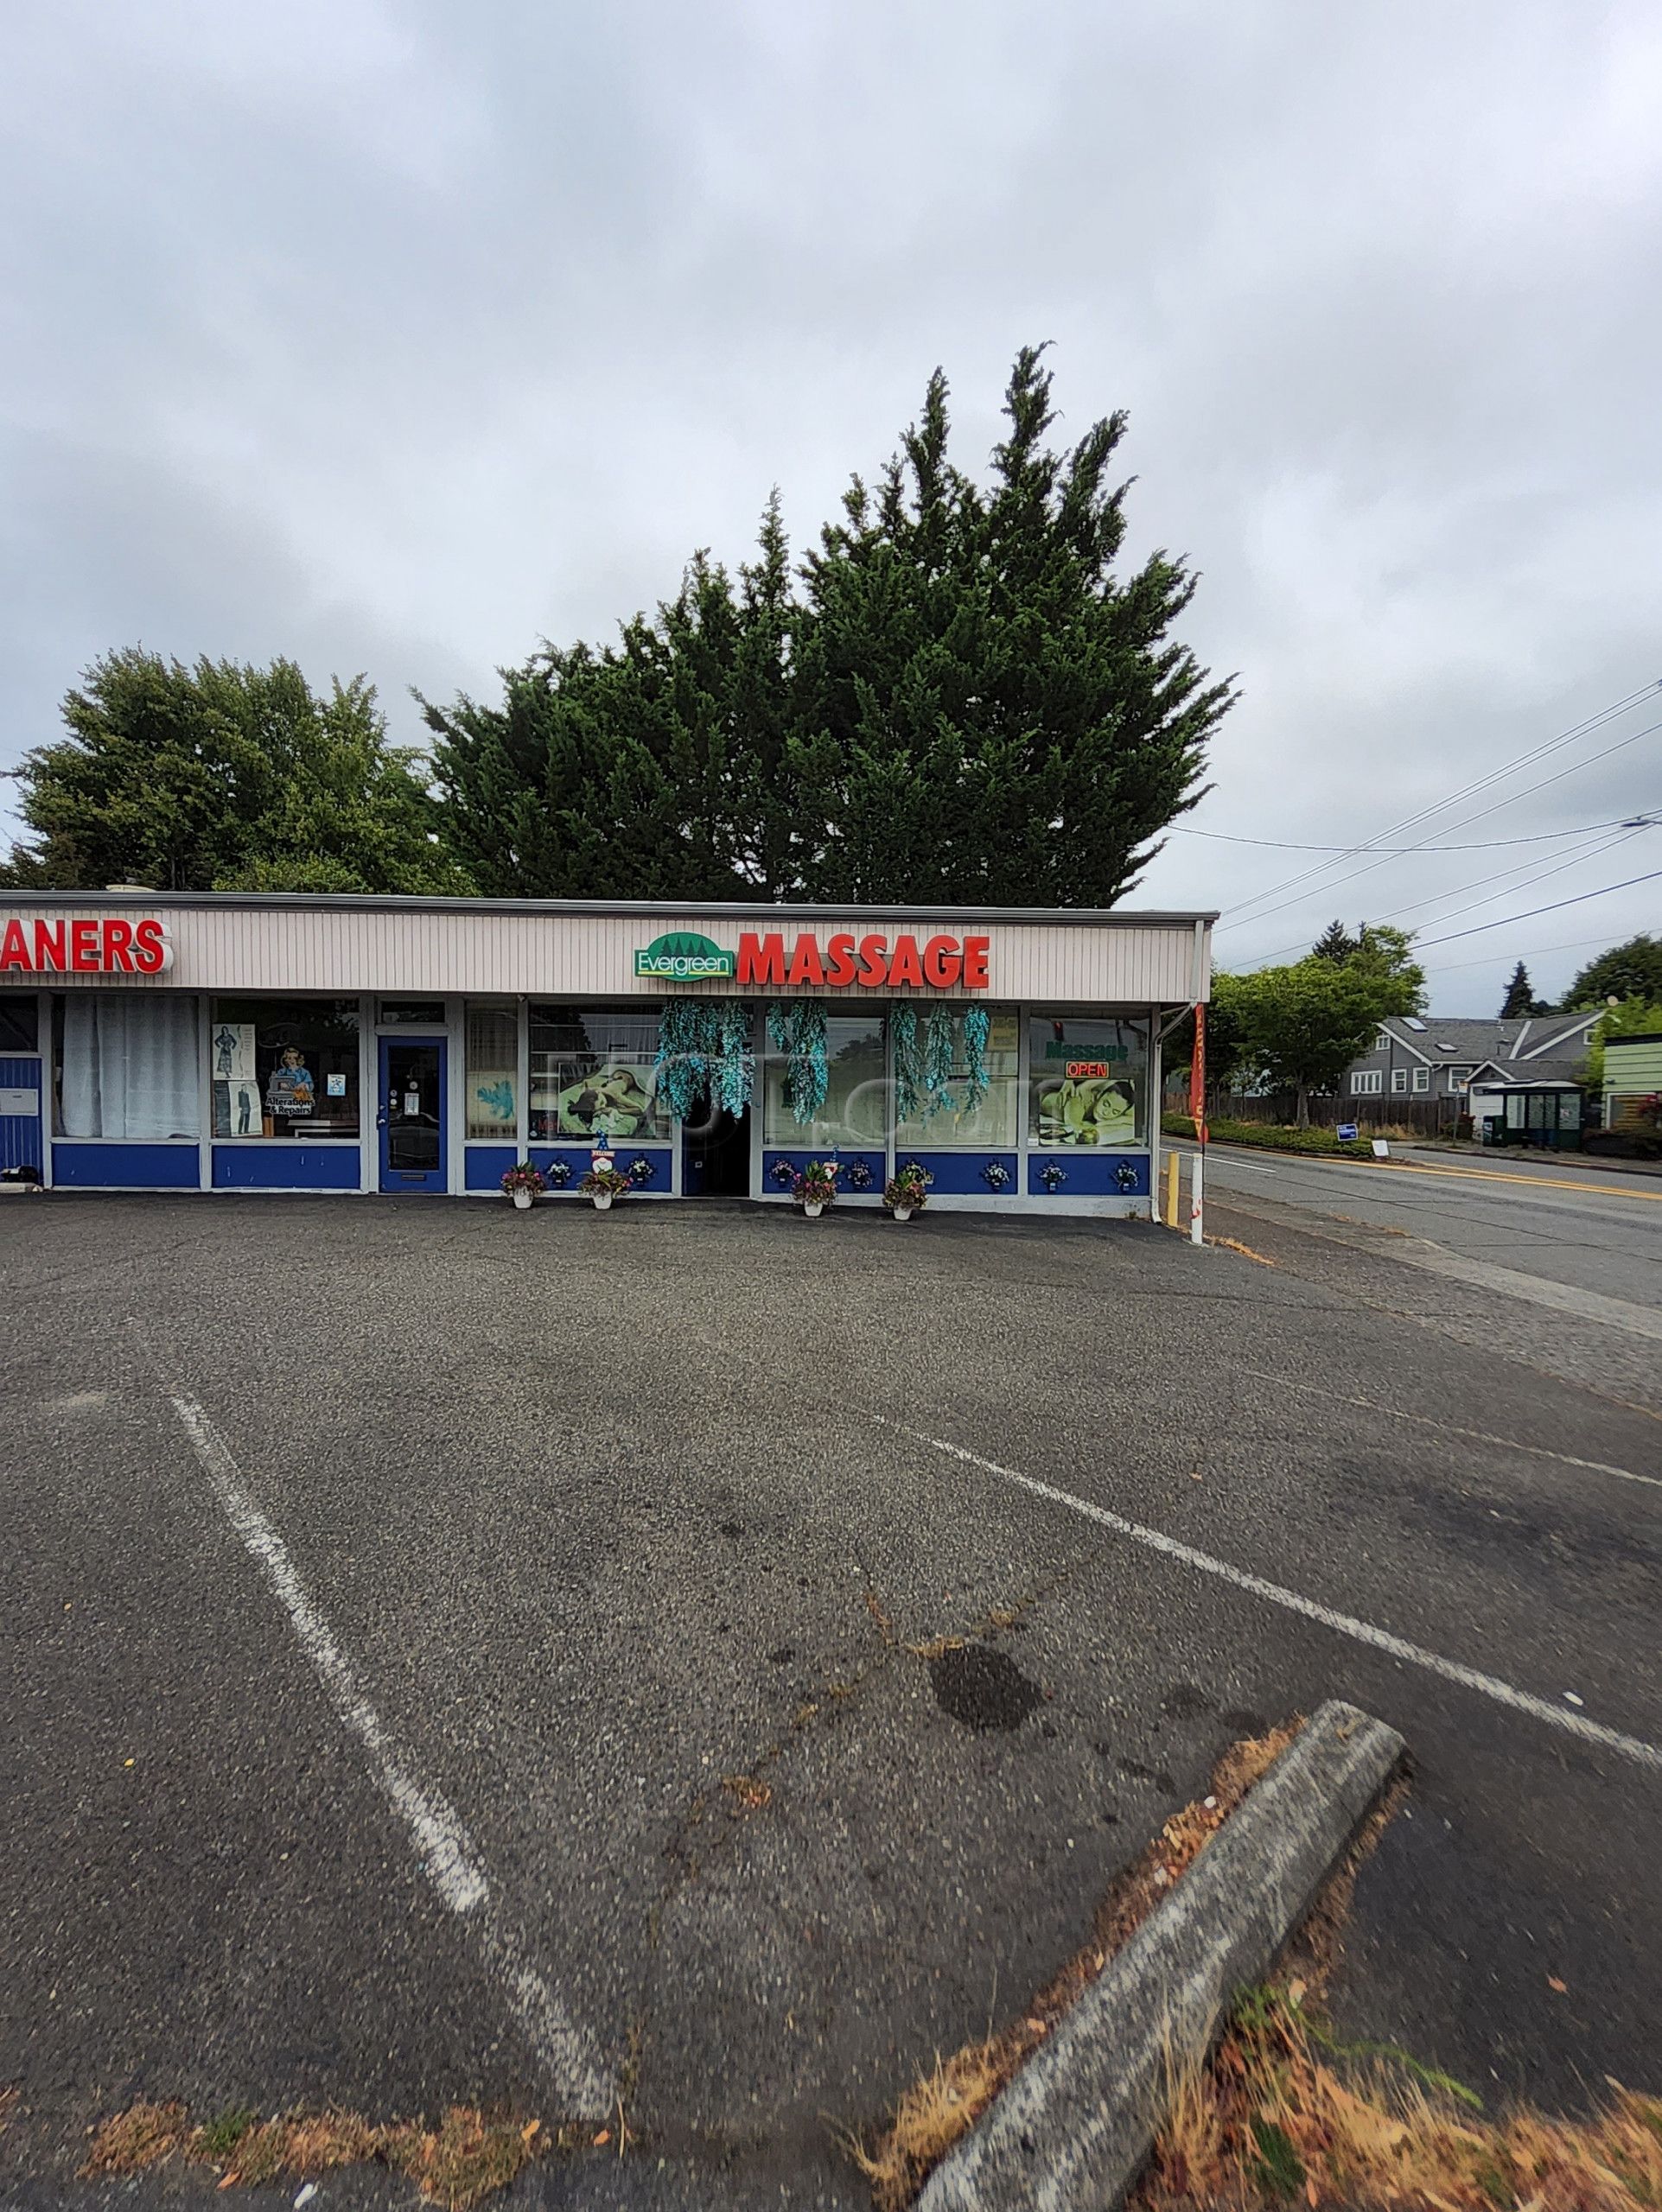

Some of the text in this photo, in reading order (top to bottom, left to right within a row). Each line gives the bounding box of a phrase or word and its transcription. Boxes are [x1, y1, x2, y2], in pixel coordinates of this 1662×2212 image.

[638, 932, 990, 989] Evergreen MASSAGE
[1046, 1041, 1129, 1062] Massage
[1067, 1063, 1107, 1077] OPEN
[266, 1096, 315, 1107] Alterations
[271, 1105, 311, 1116] & Repairs
